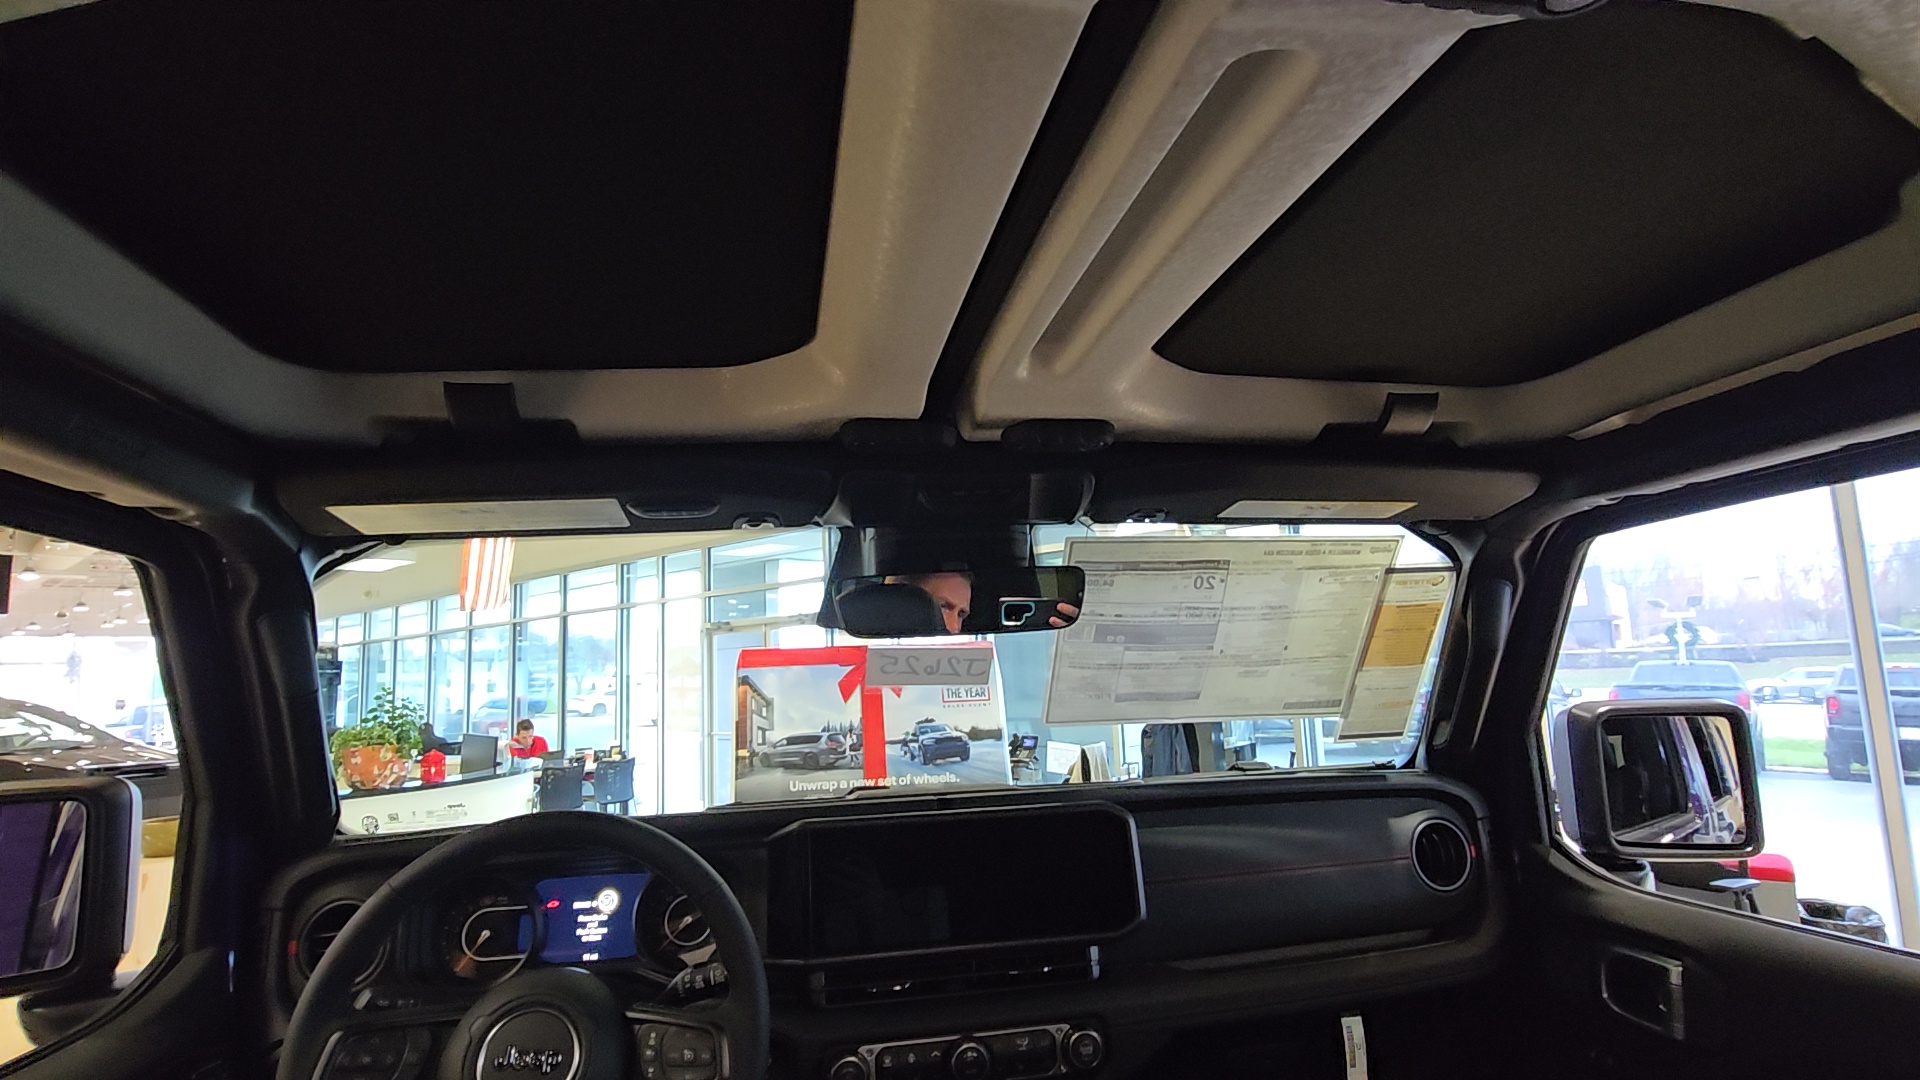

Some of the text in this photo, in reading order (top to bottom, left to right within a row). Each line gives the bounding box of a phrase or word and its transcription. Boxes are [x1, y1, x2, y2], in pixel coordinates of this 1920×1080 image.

[946, 687, 986, 699] THE YEAR
[789, 771, 961, 792] Unwrap a new set of wheels.
[494, 1045, 563, 1073] Jeep
